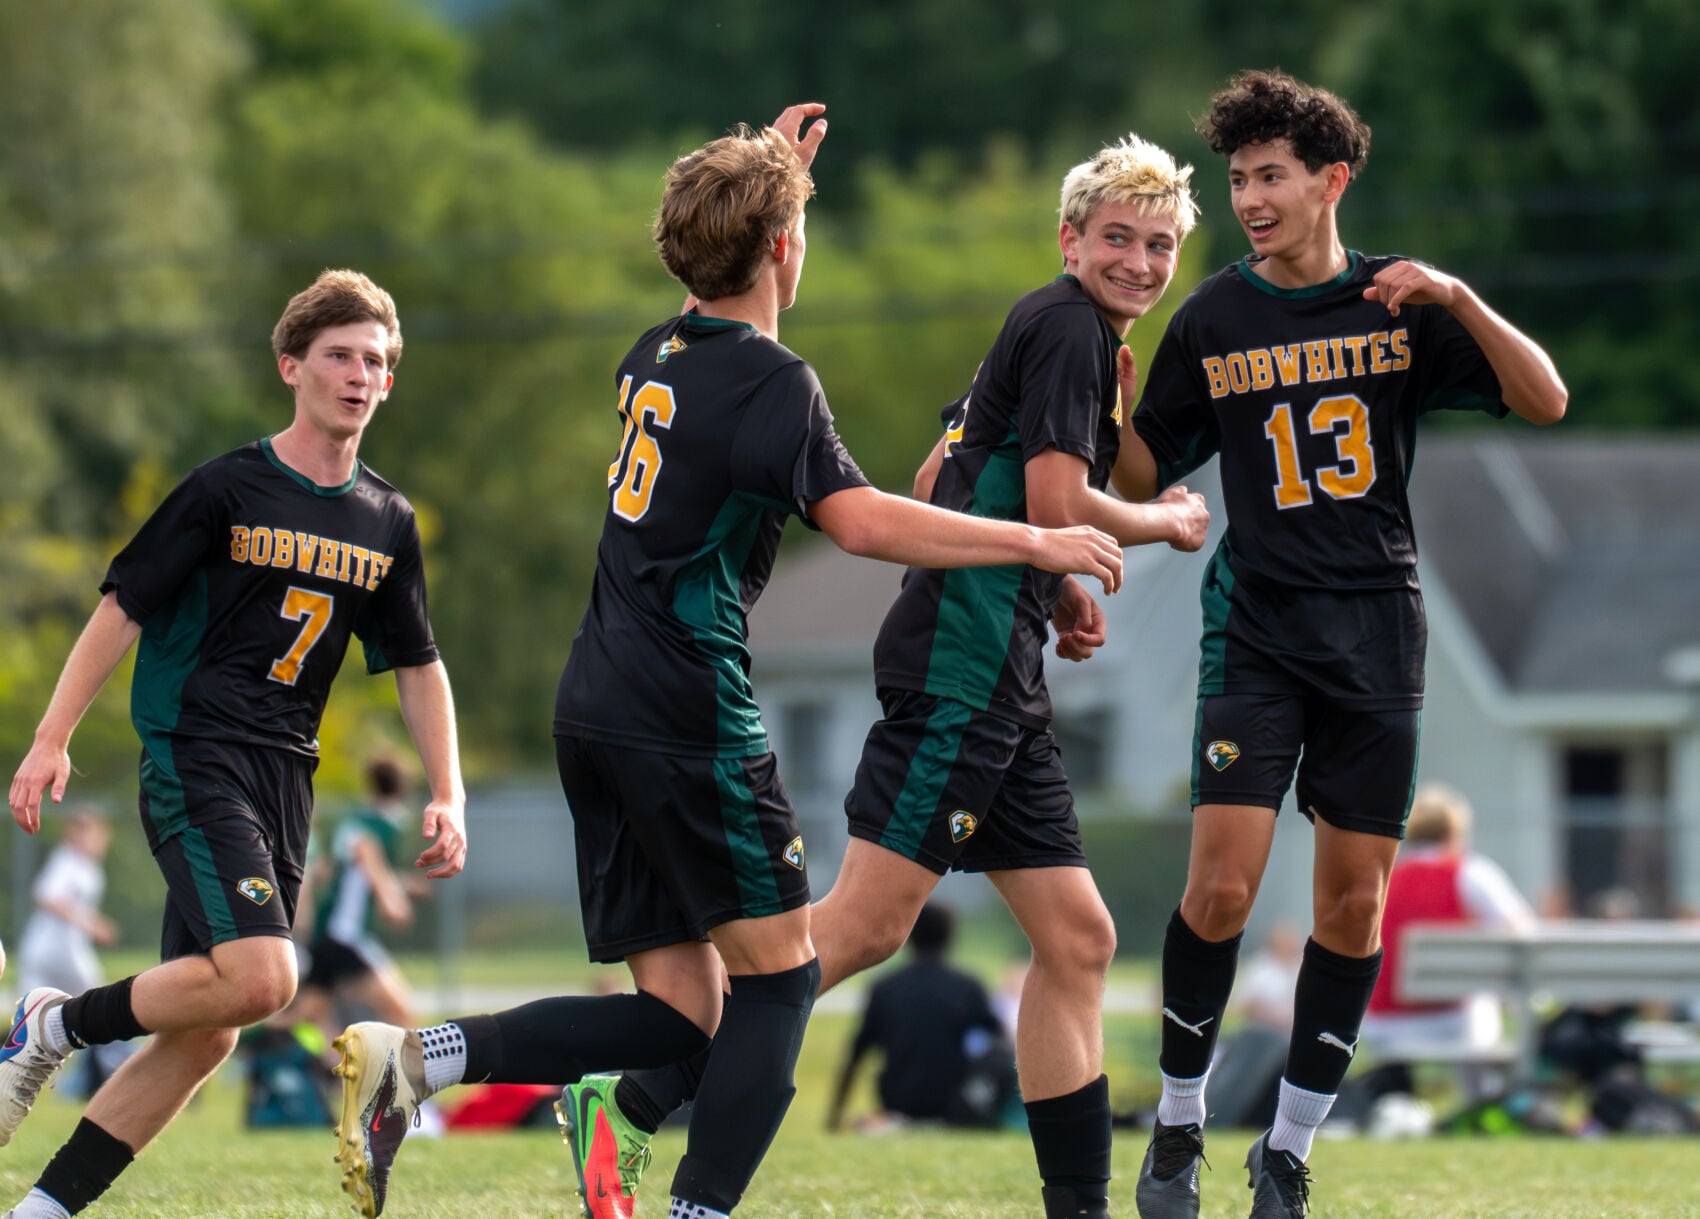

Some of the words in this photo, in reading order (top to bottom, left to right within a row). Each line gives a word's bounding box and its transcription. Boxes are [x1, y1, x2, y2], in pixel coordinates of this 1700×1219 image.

[1202, 328, 1411, 399] BOBWHITES
[1264, 394, 1377, 510] 13
[266, 585, 334, 687] 7
